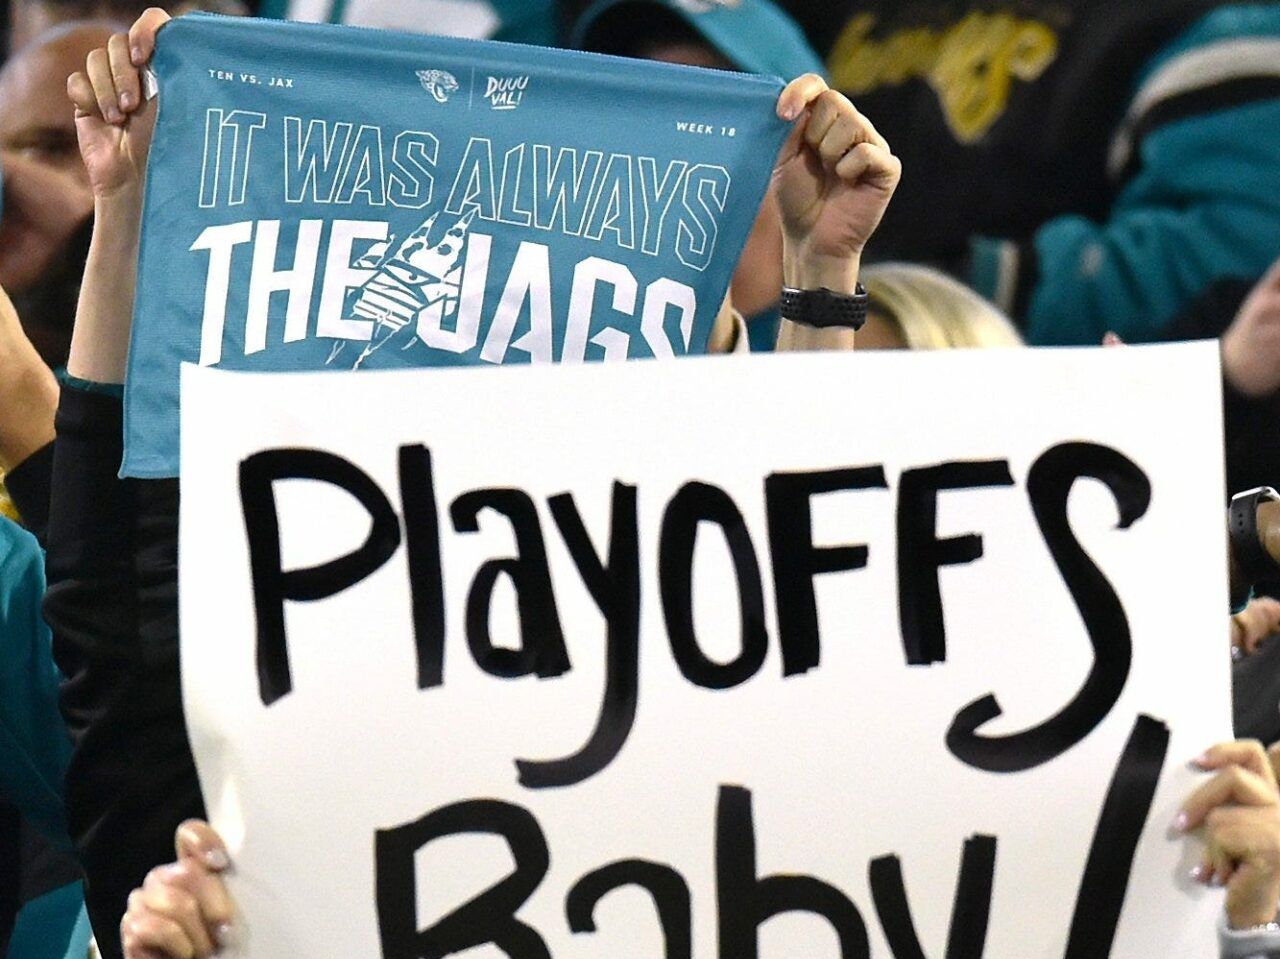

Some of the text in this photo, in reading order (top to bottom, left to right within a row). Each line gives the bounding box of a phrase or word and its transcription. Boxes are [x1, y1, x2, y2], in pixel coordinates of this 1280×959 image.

[208, 69, 294, 88] TEN VS. JAX
[484, 76, 529, 98] DUUU
[491, 91, 521, 105] VAL!
[676, 121, 737, 137] WEEK 18
[198, 107, 731, 271] IT WAS ALWAYS
[189, 219, 696, 367] THE JAGS
